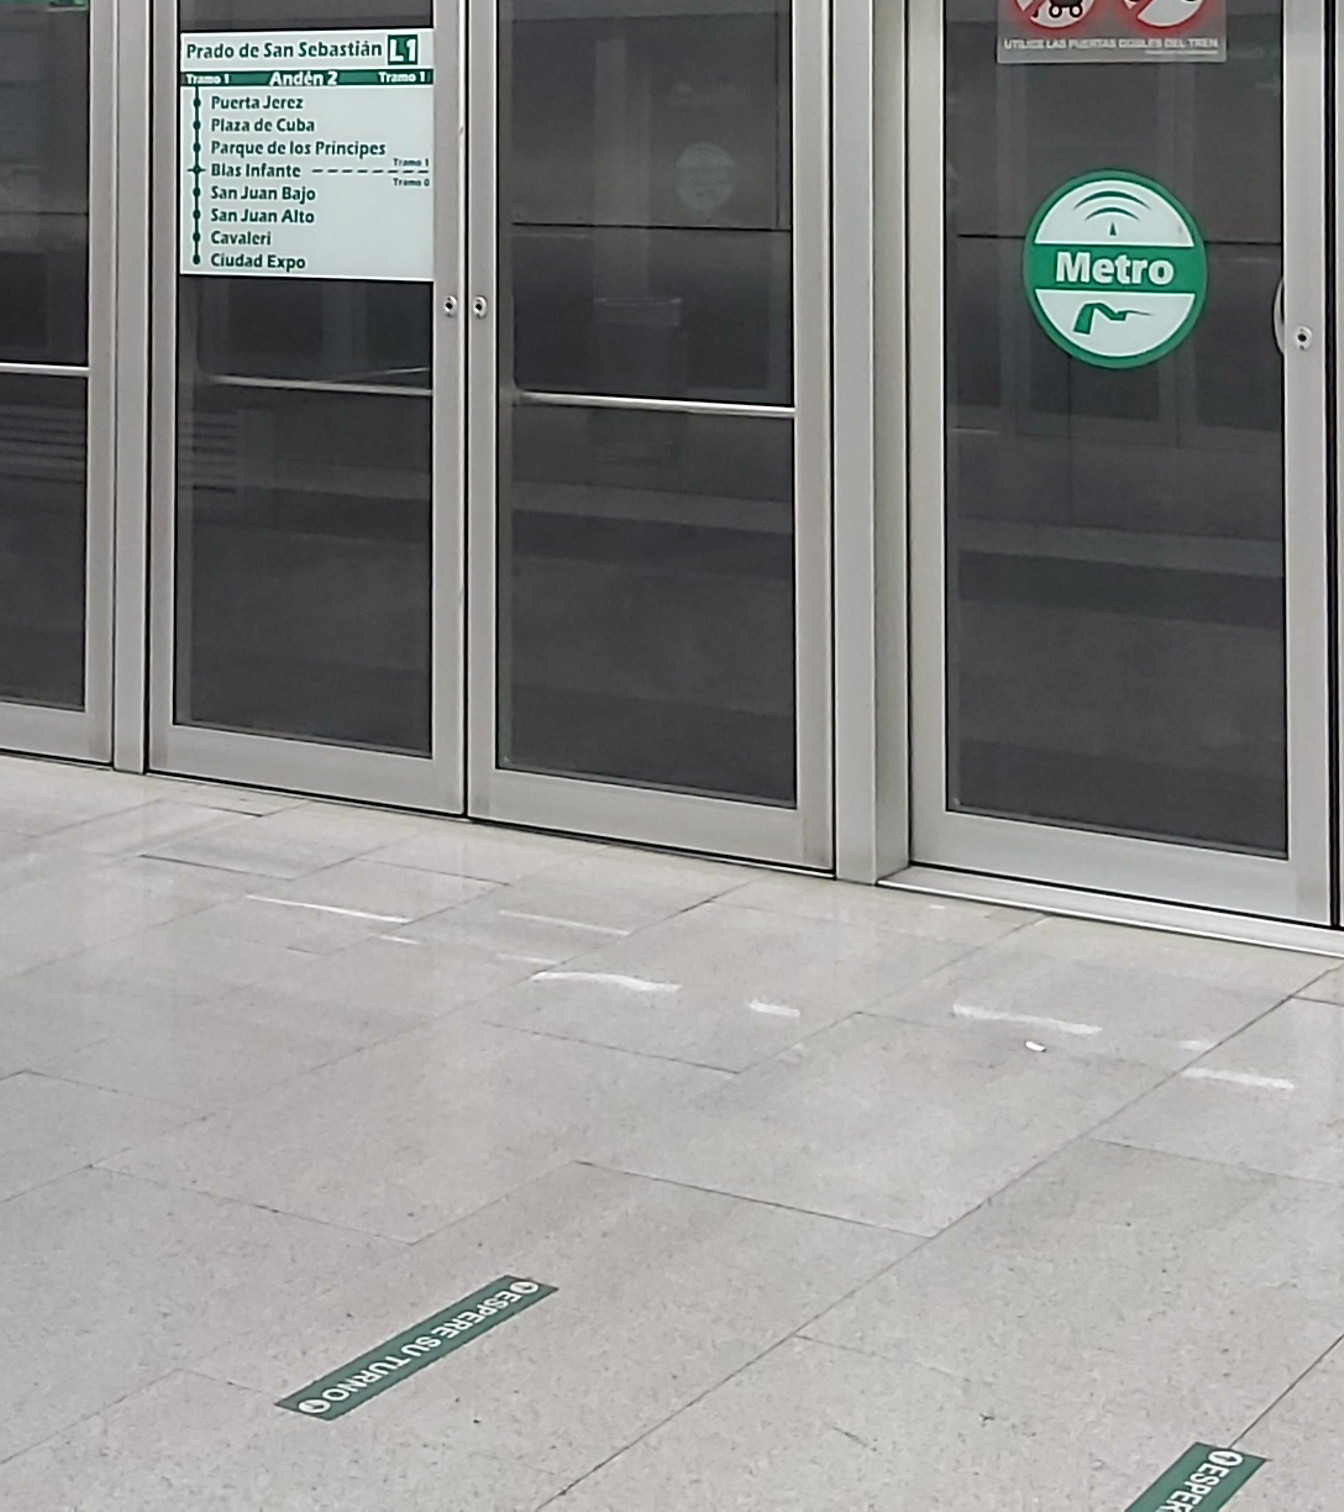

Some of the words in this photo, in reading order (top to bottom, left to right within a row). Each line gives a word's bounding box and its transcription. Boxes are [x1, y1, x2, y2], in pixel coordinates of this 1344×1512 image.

[186, 42, 234, 59] Prado
[239, 42, 260, 58] de
[263, 42, 294, 58] San
[298, 39, 382, 57] Sebastián
[389, 38, 416, 62] L1
[186, 73, 221, 84] Tramo
[224, 73, 230, 84] 1
[269, 70, 324, 86] Andén
[327, 70, 338, 86] 2
[378, 71, 416, 83] Tramo
[419, 71, 426, 83] 1
[211, 95, 260, 110] Puerta
[262, 95, 304, 110] Jerez
[211, 117, 250, 132] Plaza
[254, 118, 273, 132] de
[276, 118, 315, 132] Cuba
[211, 140, 264, 158] Parque
[267, 140, 286, 155] de
[289, 141, 311, 155] los
[211, 163, 241, 177] Blas
[245, 163, 301, 178] Infante
[393, 157, 422, 167] Tramo
[210, 186, 237, 200] San
[241, 185, 277, 200] Juan
[282, 186, 316, 204] Bajo
[210, 208, 237, 223] San
[241, 208, 277, 223] Juan
[281, 209, 315, 223] Alto
[210, 230, 271, 246] Cavaleri
[210, 252, 263, 268] Ciudad
[267, 254, 306, 273] Expo
[1056, 251, 1174, 285] Metro
[431, 1290, 522, 1339] ESPERE
[401, 1336, 442, 1357] SU
[322, 1355, 411, 1402] TURNO
